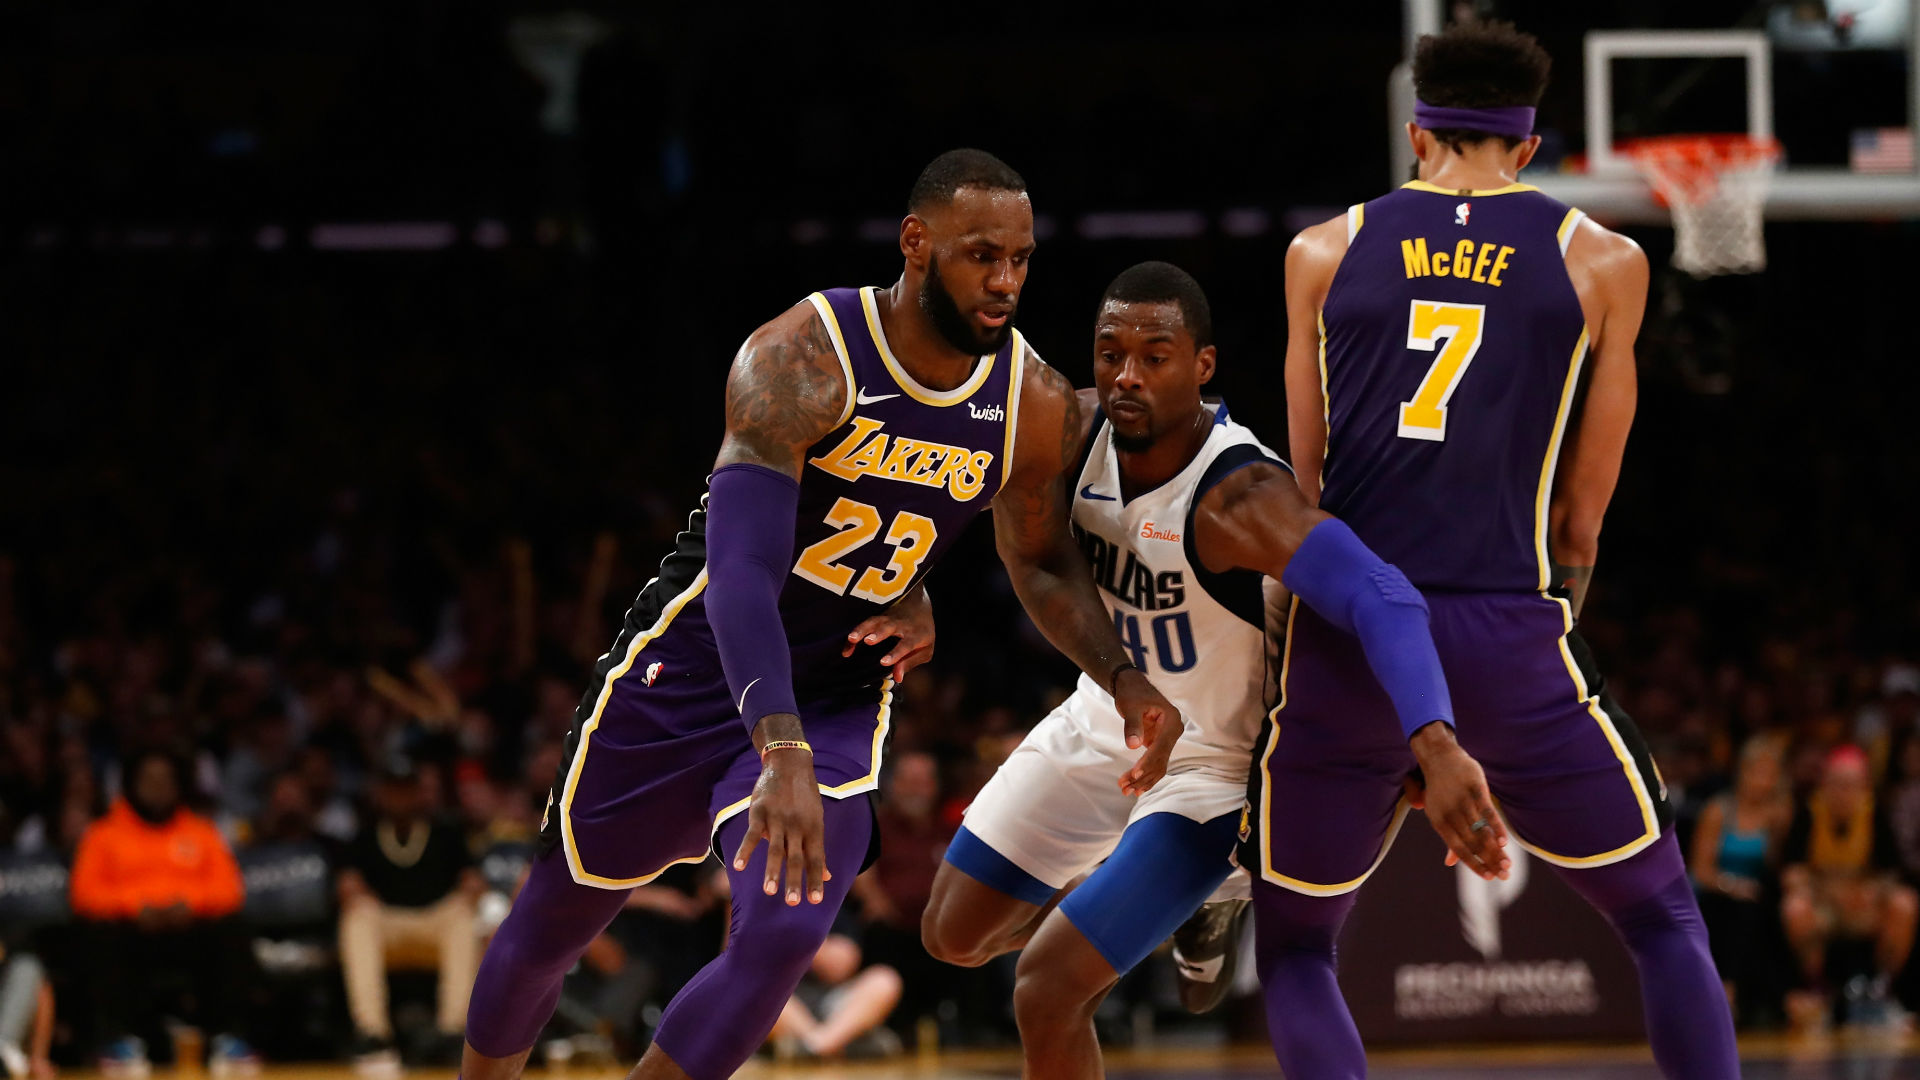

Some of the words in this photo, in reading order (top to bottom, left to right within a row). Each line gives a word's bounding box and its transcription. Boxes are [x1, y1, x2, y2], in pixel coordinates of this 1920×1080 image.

[1400, 237, 1516, 287] McGEE
[1397, 299, 1486, 441] 7
[967, 402, 1004, 422] wish
[808, 415, 994, 502] LAKERS
[792, 496, 938, 604] 23
[1140, 522, 1181, 543] 5miles
[1113, 608, 1198, 675] 40
